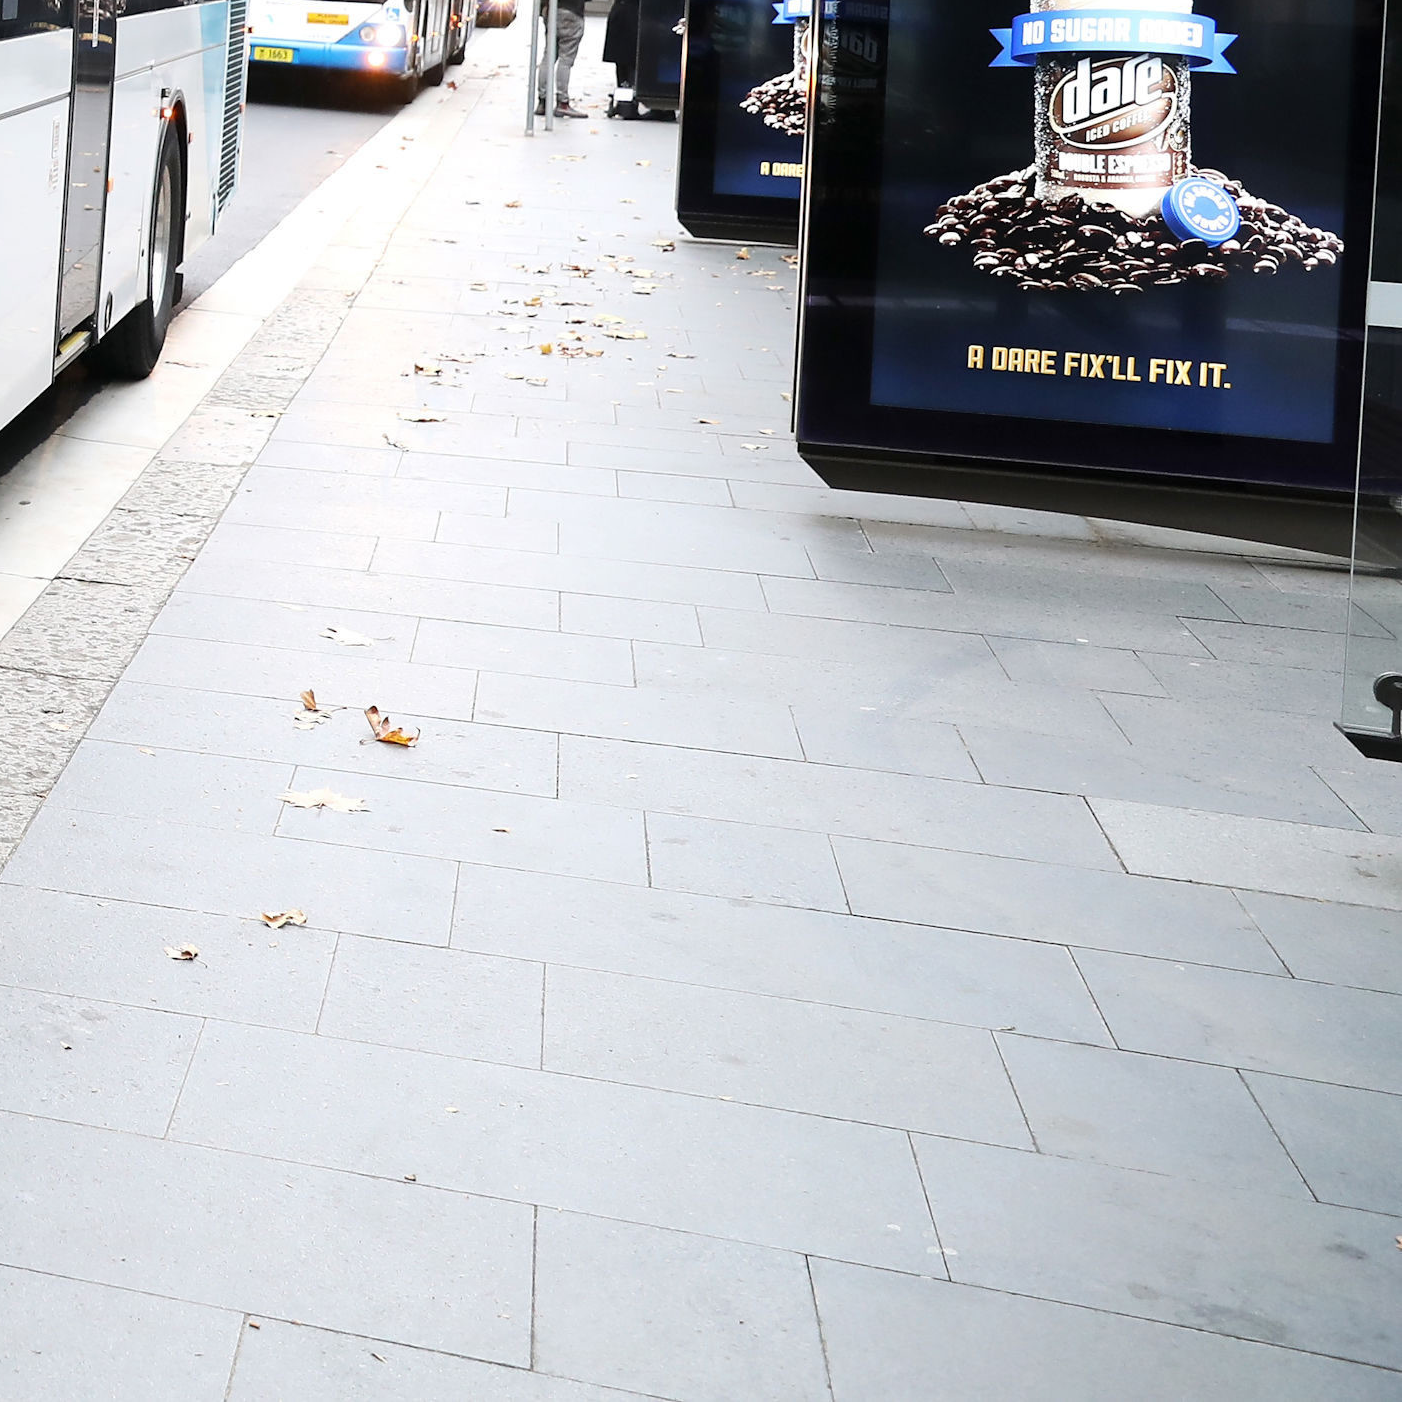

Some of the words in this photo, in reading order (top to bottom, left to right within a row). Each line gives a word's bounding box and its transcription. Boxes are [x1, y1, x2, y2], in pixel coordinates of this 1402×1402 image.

[1022, 19, 1045, 45] NO
[1050, 18, 1132, 43] SUGAR
[1063, 53, 1164, 125] dare
[1085, 119, 1111, 143] ICED
[1113, 109, 1152, 135] COFFEE
[967, 345, 984, 369] A
[992, 346, 1057, 375] DARE
[1064, 351, 1141, 382] FIX'LL
[1149, 358, 1193, 385] FIX
[1199, 361, 1232, 389] IT.
